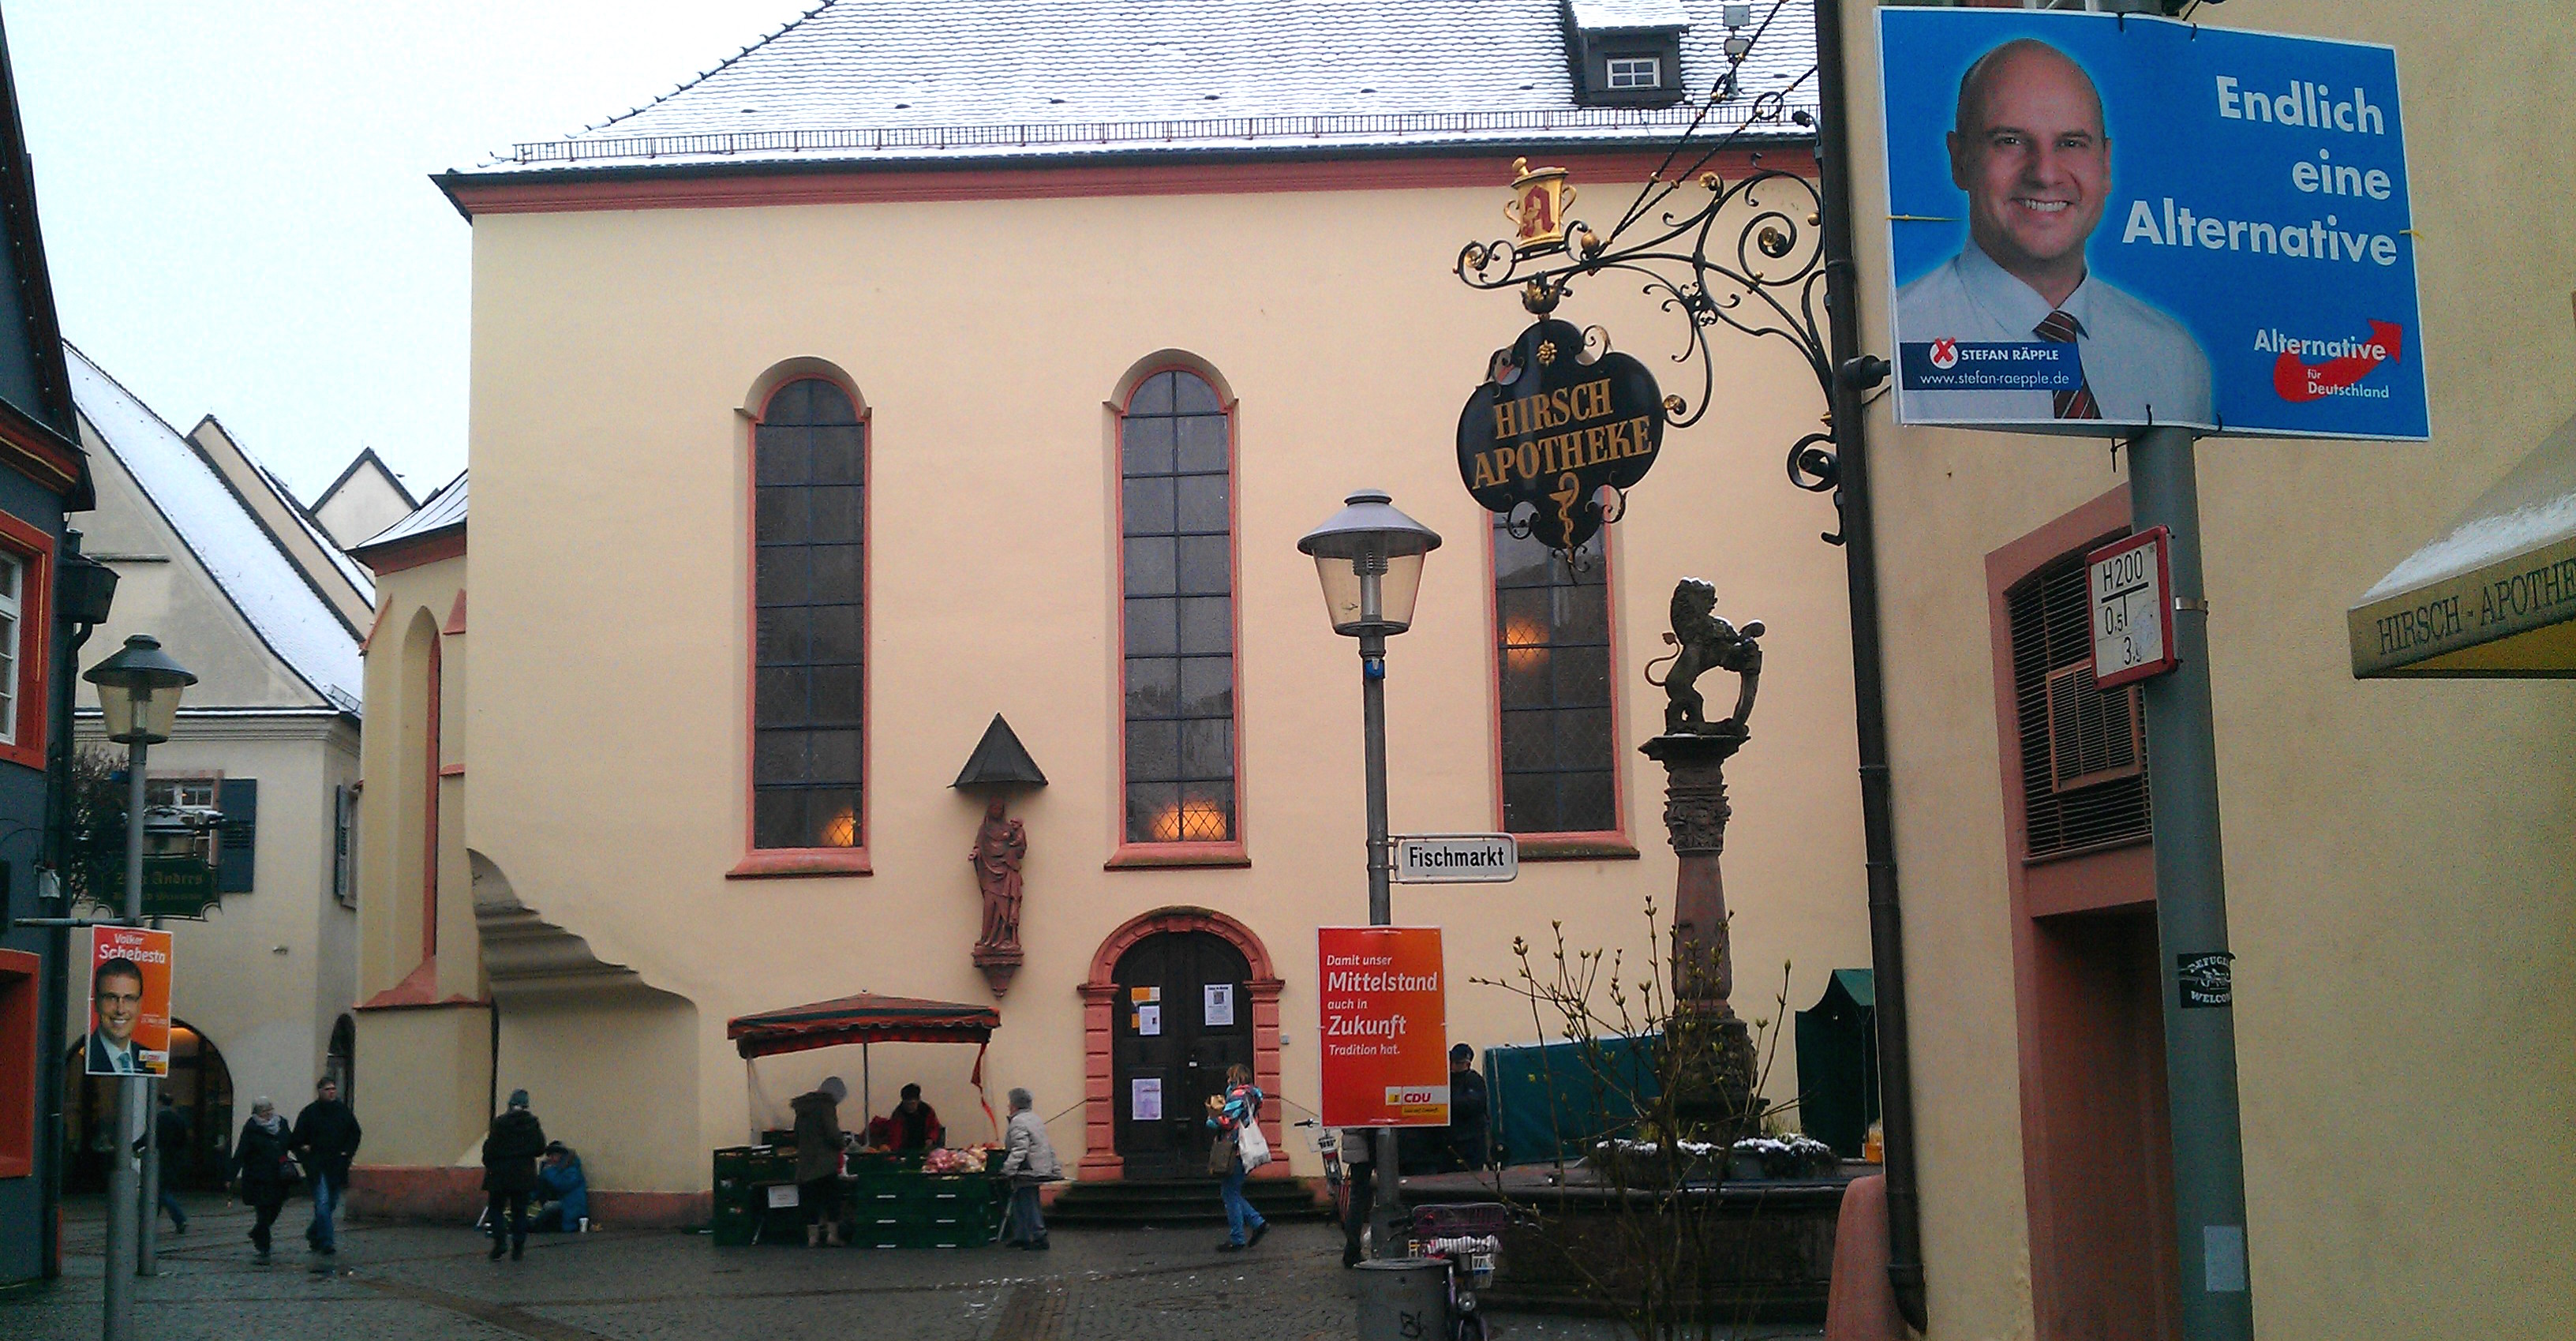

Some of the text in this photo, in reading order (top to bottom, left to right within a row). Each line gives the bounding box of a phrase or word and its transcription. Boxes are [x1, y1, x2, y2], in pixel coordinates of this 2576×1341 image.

[2215, 75, 2385, 135] Endlich
[2293, 149, 2392, 200] eine
[2122, 198, 2397, 266] Alternative
[1961, 346, 2059, 361] STEFAN RÄPPLE
[2254, 328, 2387, 361] Alternative
[1920, 370, 2069, 388] www.stefan-raepple.de
[2307, 369, 2322, 380] für
[2308, 382, 2389, 398] Deutschland
[1494, 379, 1613, 440] HIRSCH
[1473, 415, 1653, 490] APOTHEKE
[2102, 550, 2144, 592] H200
[2376, 595, 2462, 655] HIRSCH
[2481, 558, 2576, 626] APOTHE
[1409, 846, 1505, 867] Fischmarkt
[114, 934, 144, 945] Volker
[99, 944, 166, 964] Schebesta
[1327, 955, 1392, 966] Damit unser
[1327, 972, 1438, 991] Mittelstand
[1327, 998, 1367, 1009] auch in
[1327, 1014, 1406, 1039] Zukunft
[1329, 1043, 1400, 1055] Tradition hat.
[1404, 1092, 1432, 1103] CDU
